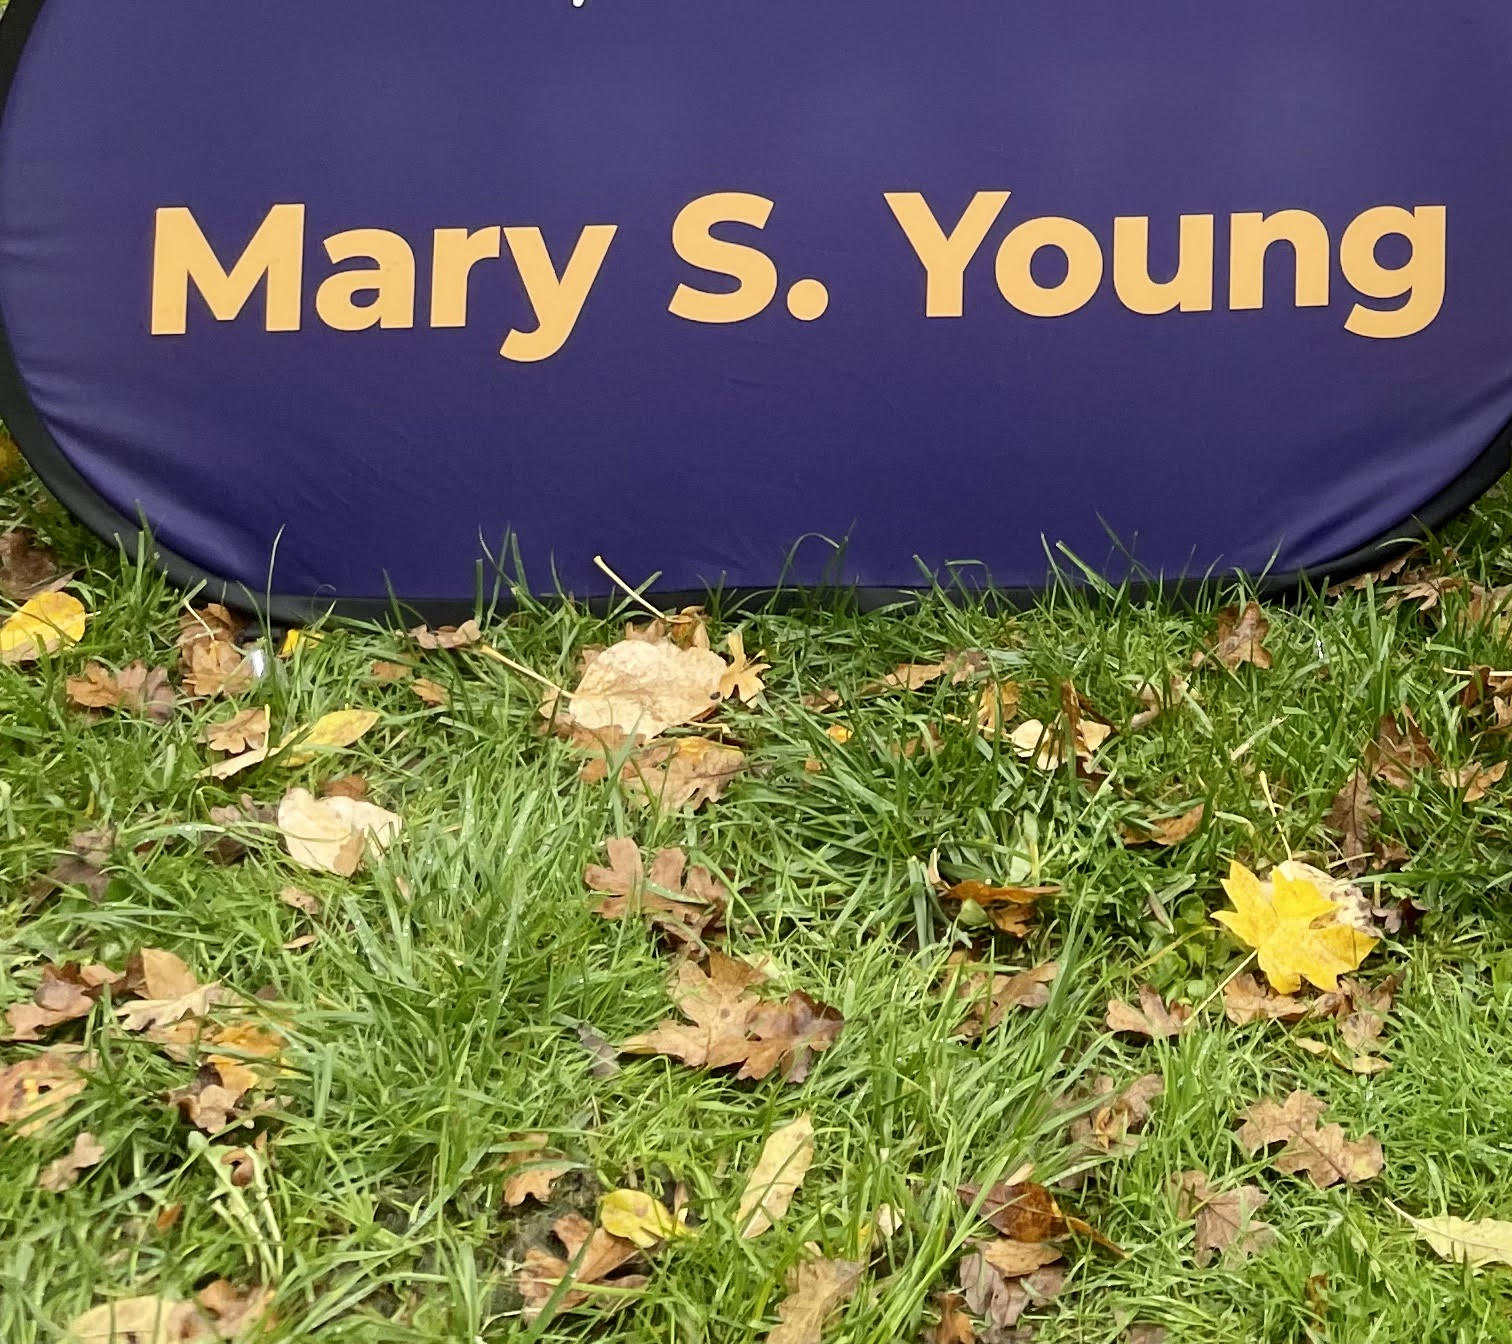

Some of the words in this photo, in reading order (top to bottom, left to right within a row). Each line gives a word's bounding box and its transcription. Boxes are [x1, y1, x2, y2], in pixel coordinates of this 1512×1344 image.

[150, 203, 618, 363] Mary
[666, 191, 830, 323] S.
[883, 190, 1447, 339] Young
